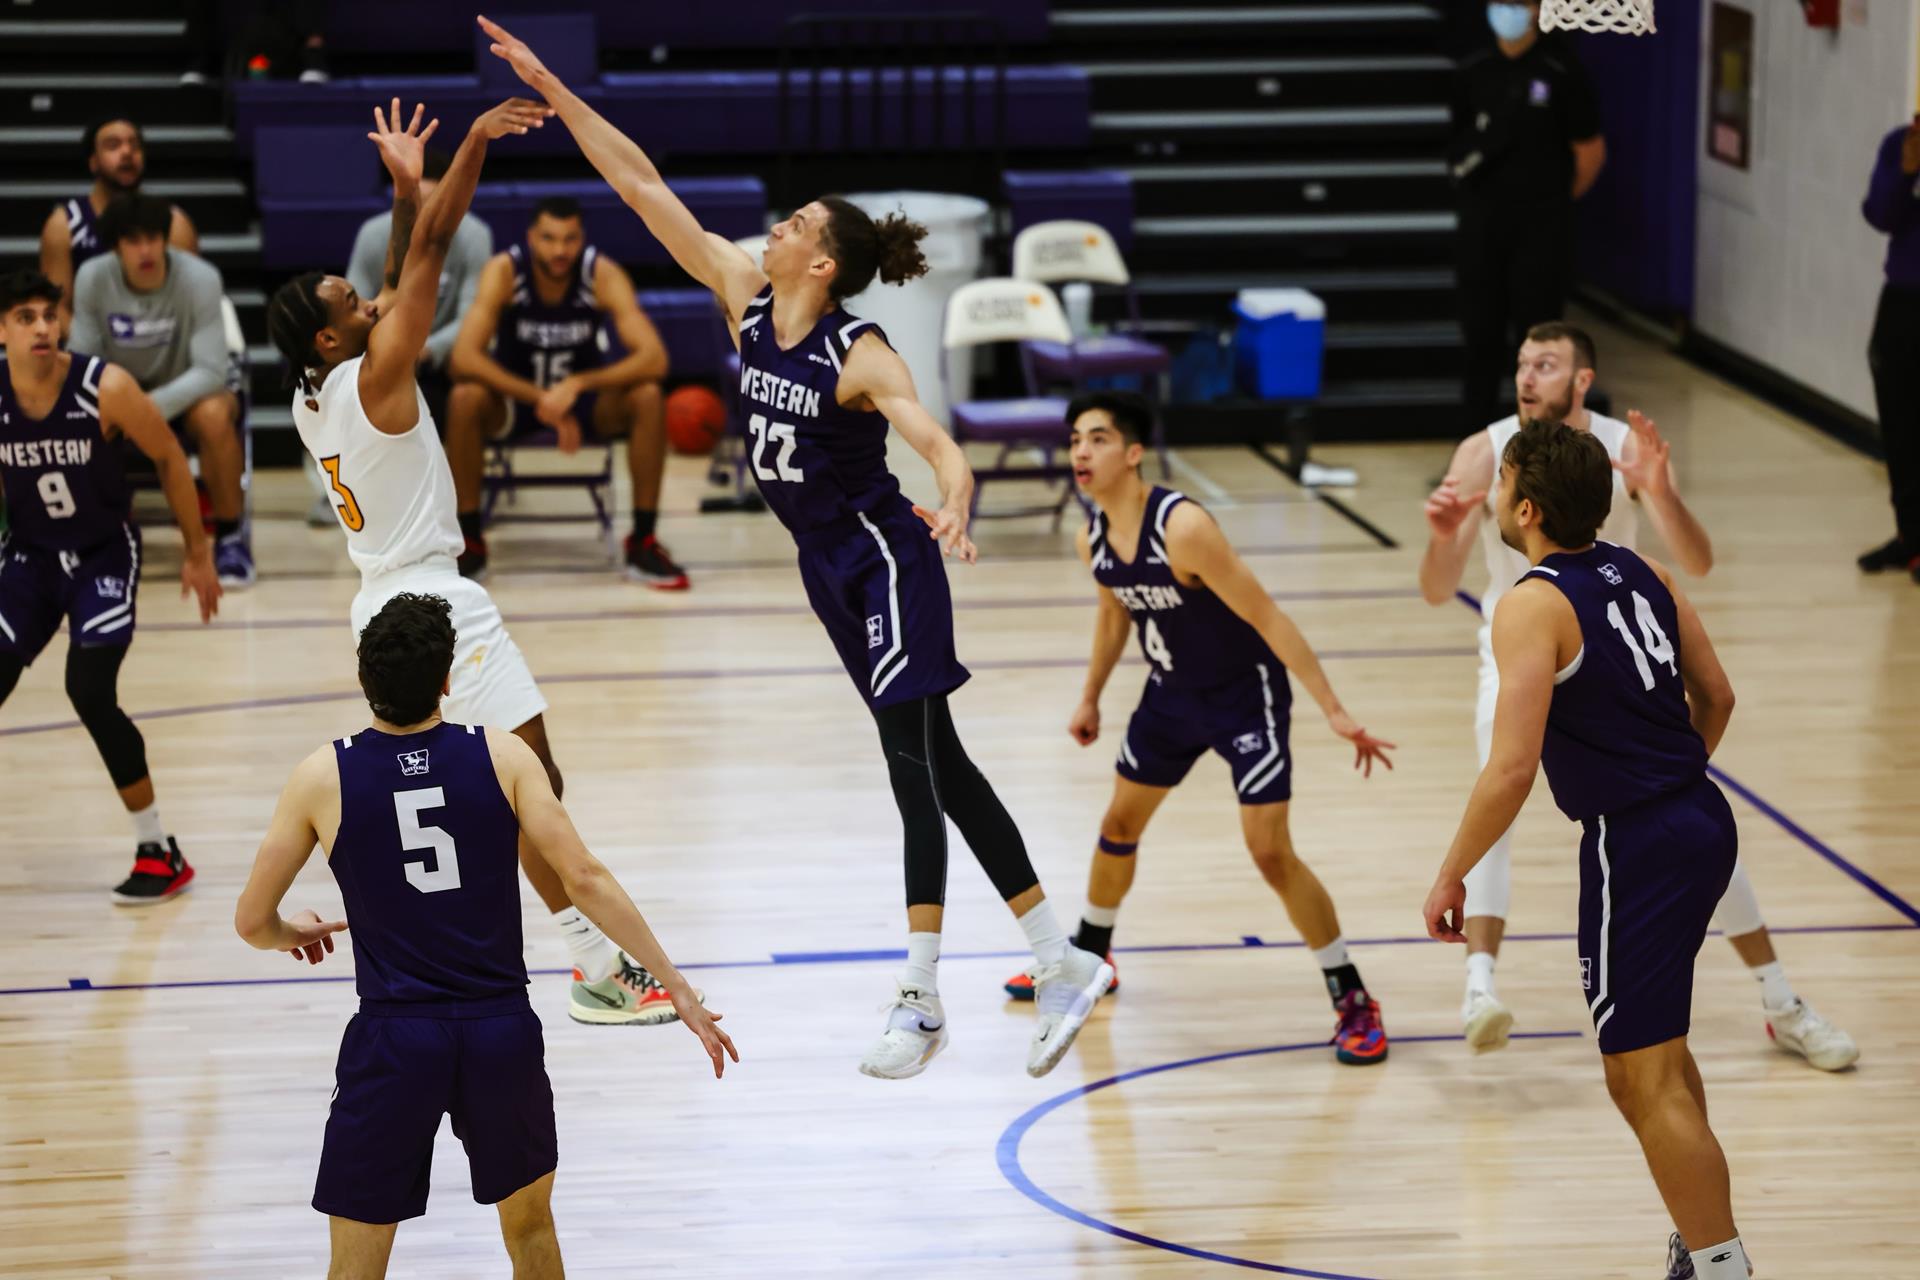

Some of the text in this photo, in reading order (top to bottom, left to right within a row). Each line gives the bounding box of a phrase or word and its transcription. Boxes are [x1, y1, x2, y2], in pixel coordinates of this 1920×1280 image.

[741, 361, 820, 418] WESTERN
[0, 439, 92, 467] WESTERN
[749, 413, 804, 482] 22
[37, 471, 76, 519] 9
[320, 454, 365, 532] 3
[1145, 617, 1173, 671] 4
[1607, 590, 1678, 691] 14
[393, 786, 461, 893] 5
